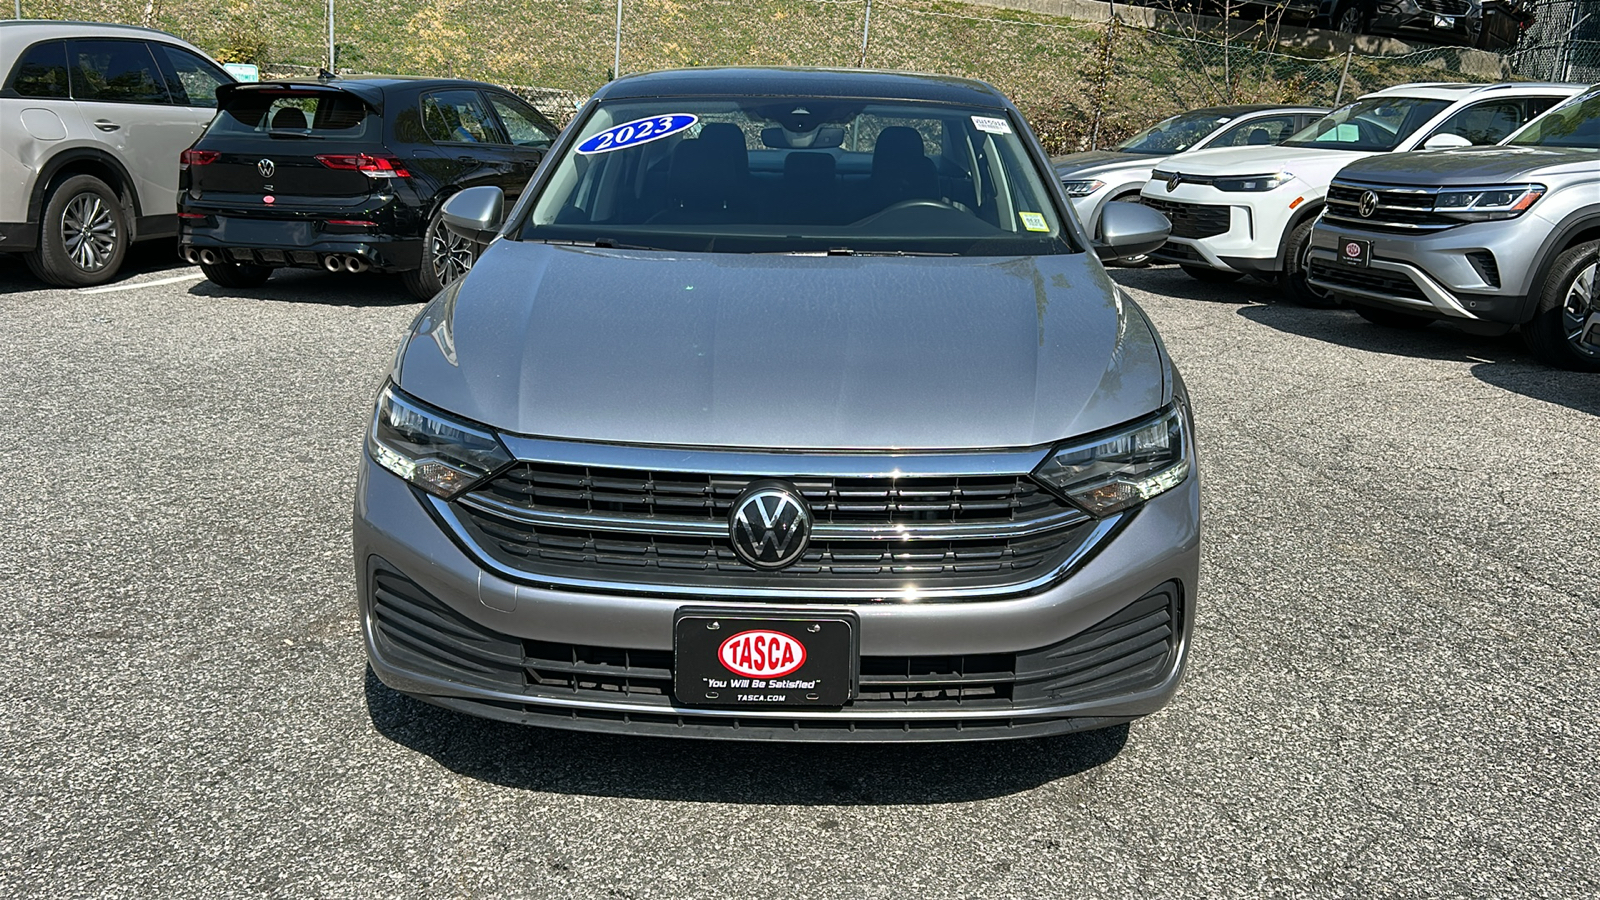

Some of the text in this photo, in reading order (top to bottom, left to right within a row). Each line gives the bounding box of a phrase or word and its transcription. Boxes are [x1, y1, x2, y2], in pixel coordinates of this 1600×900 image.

[594, 116, 674, 151] 2023
[258, 158, 275, 178] VW
[735, 489, 805, 562] VW
[729, 635, 795, 671] TASCA
[702, 677, 821, 689] "You Will Be Satisfied"
[737, 694, 786, 702] TASCA.COM
